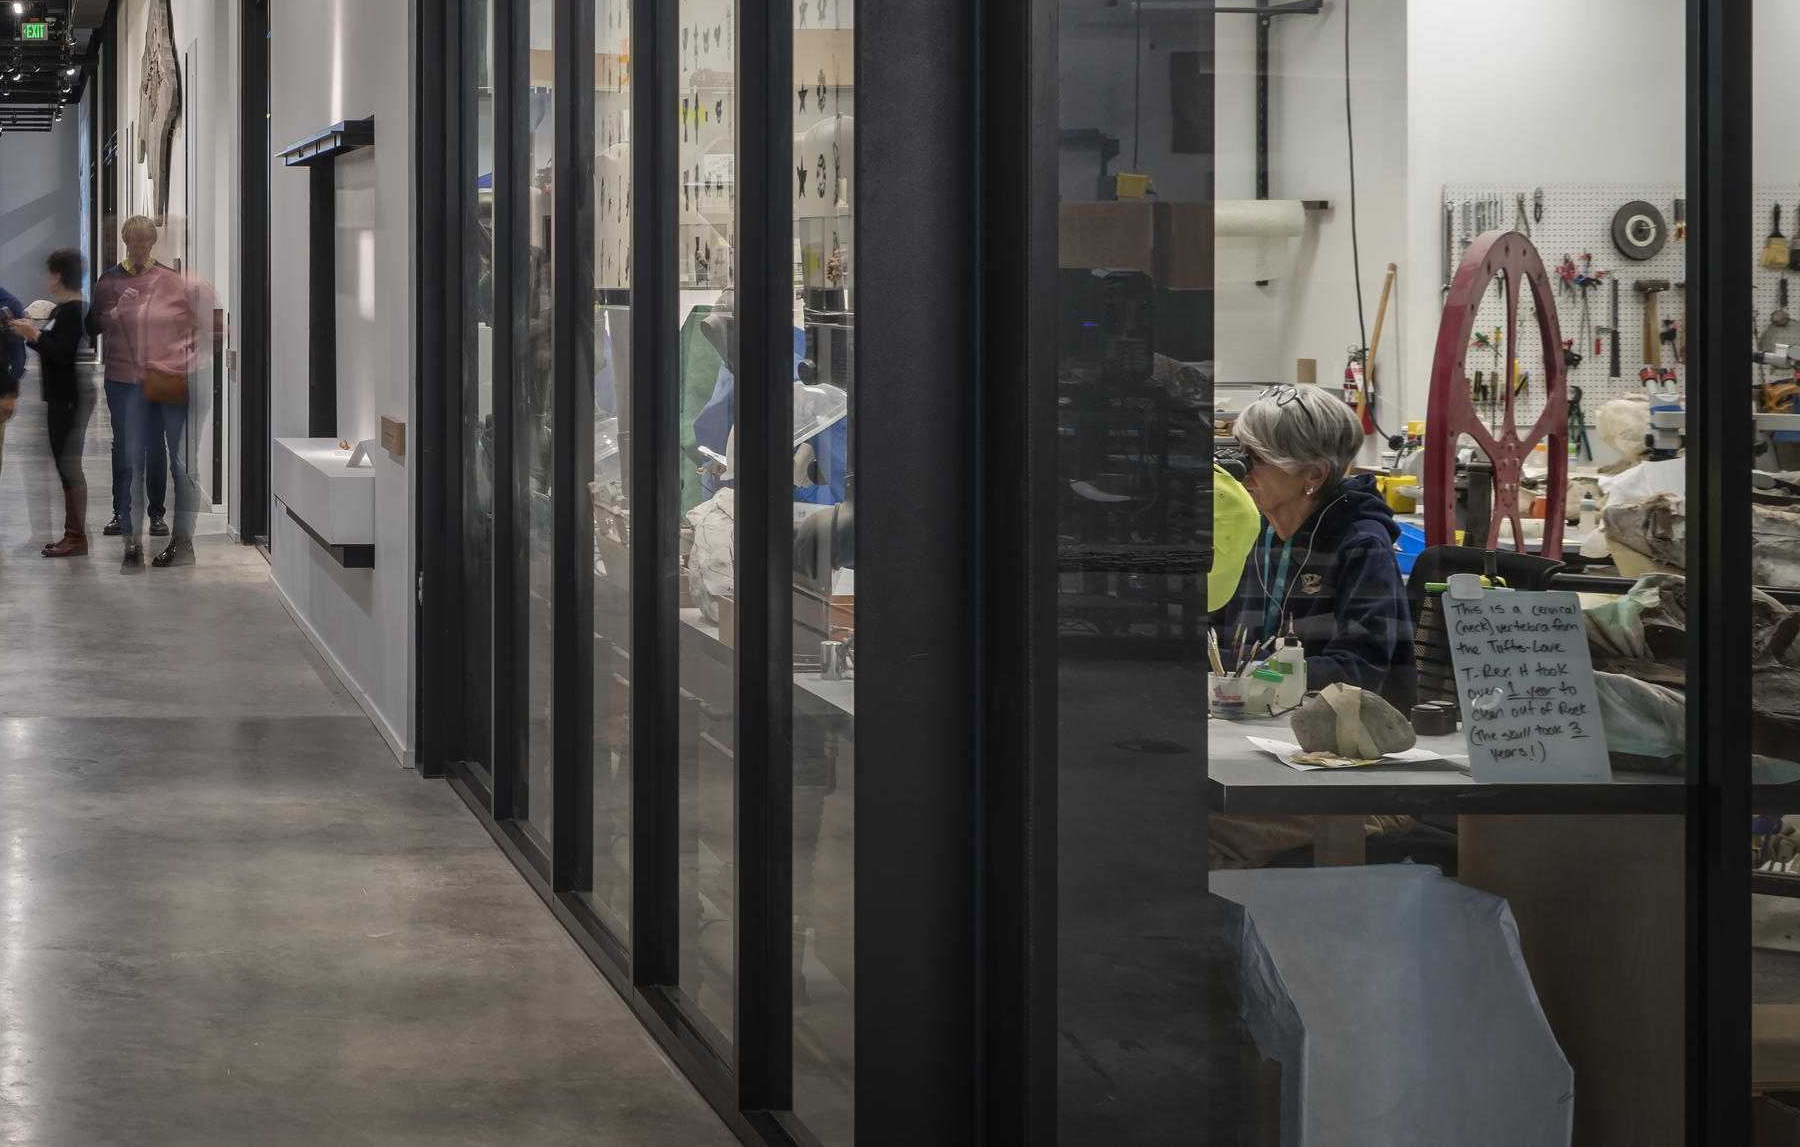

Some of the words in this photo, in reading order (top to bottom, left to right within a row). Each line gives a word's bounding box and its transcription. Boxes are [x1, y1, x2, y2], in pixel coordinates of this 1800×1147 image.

[27, 24, 44, 38] EXIT
[1451, 603, 1482, 615] This
[1490, 604, 1505, 614] is
[1512, 605, 1522, 614] a
[1531, 603, 1576, 616] cervical
[1455, 617, 1494, 636] (neck)
[1495, 620, 1550, 634] vertebra
[1551, 617, 1579, 631] from
[1455, 642, 1481, 655] the
[1535, 662, 1568, 677] took
[1526, 686, 1557, 701] year
[1559, 681, 1577, 696] to
[1471, 708, 1505, 722] clean
[1511, 700, 1536, 718] out
[1540, 701, 1554, 715] of
[1501, 726, 1531, 742] skull
[1535, 724, 1563, 736] took
[1568, 721, 1582, 734] 3
